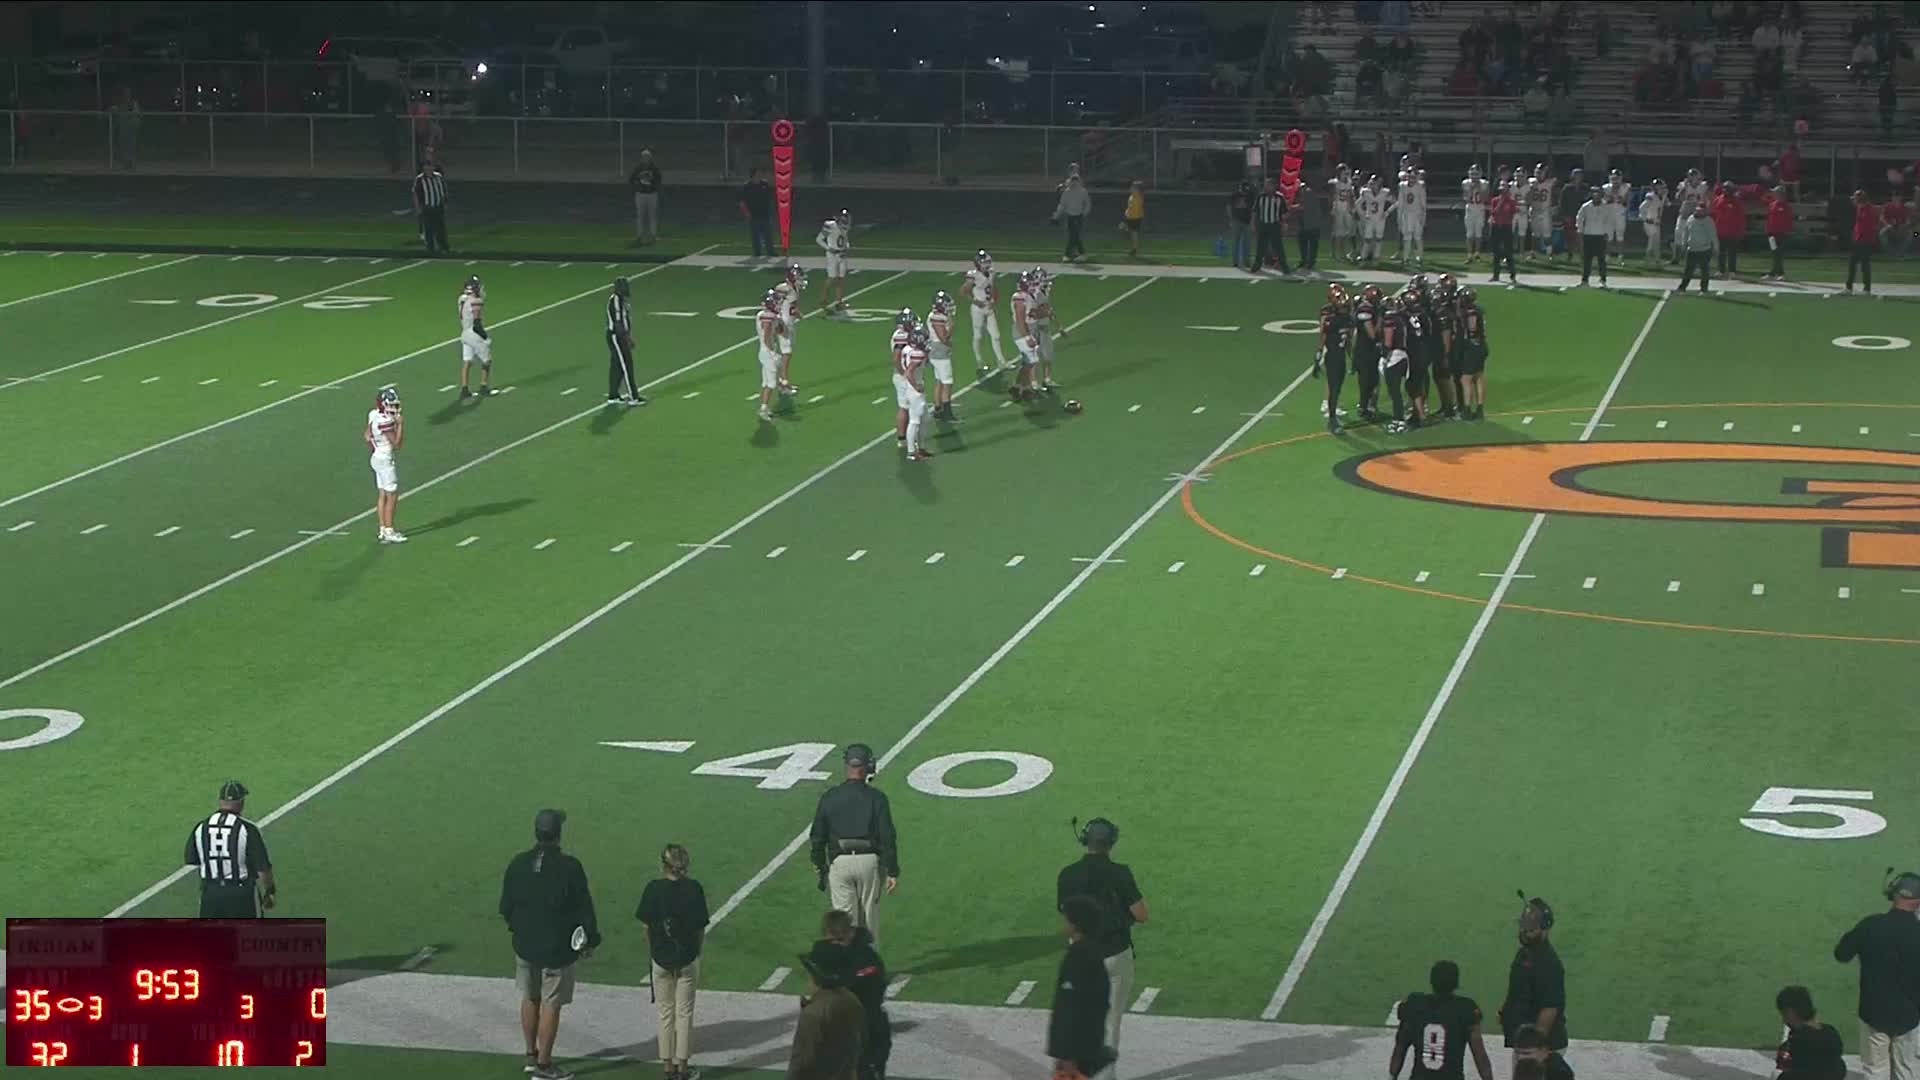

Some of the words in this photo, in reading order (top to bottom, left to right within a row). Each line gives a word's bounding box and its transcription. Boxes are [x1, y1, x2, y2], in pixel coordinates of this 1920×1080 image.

[691, 741, 1054, 798] 40
[208, 827, 232, 858] H
[1422, 1023, 1446, 1070] 8
